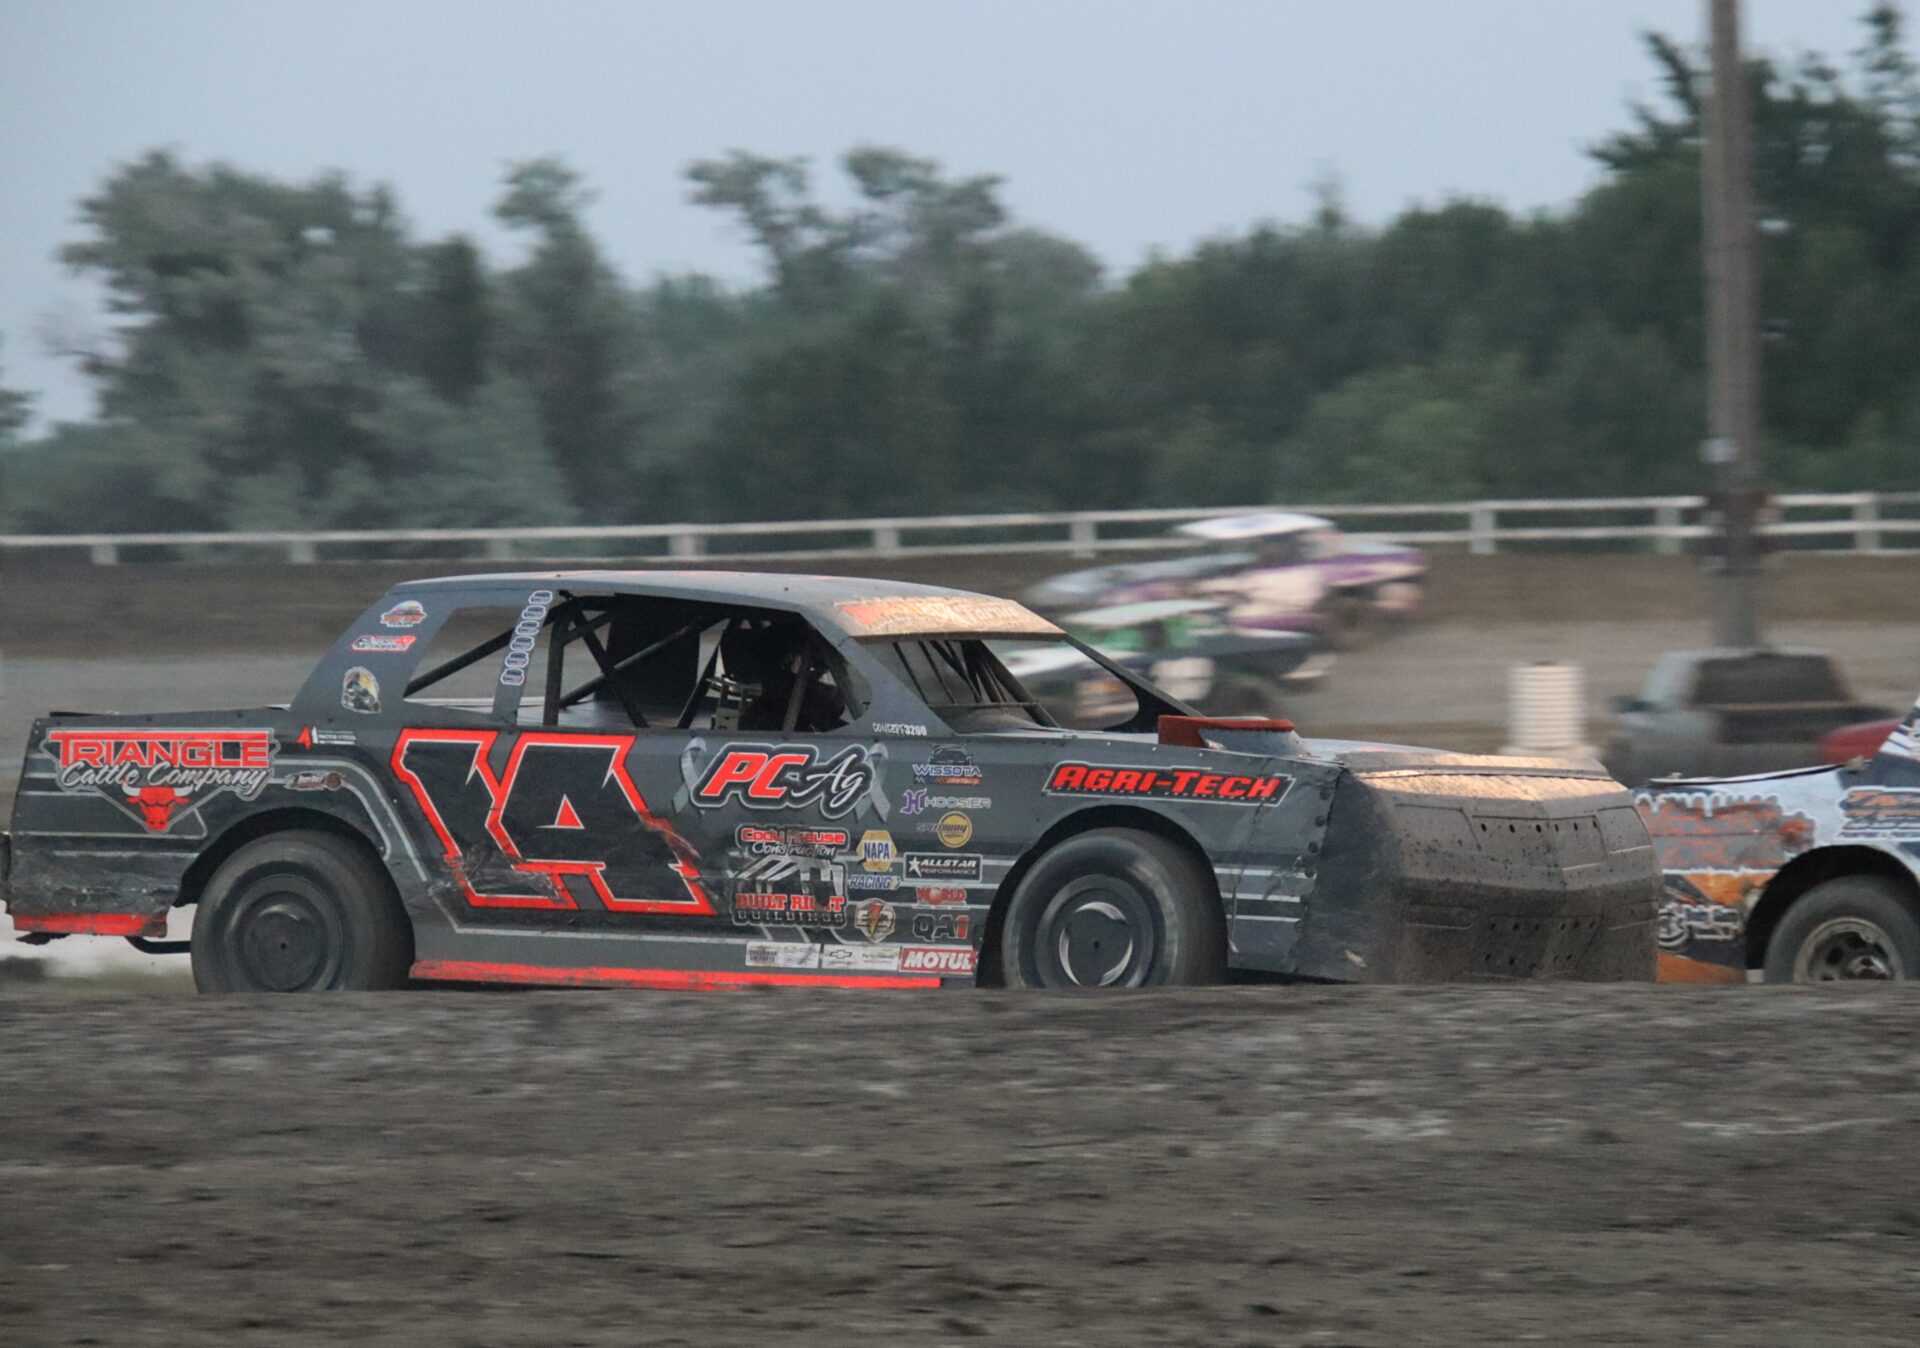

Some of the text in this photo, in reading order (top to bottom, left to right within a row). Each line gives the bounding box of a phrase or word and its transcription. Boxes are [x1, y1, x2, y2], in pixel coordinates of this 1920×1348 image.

[50, 731, 270, 768] TRIANGLE
[61, 760, 140, 787] Cattle
[147, 760, 269, 796] Company
[913, 764, 983, 777] WISSOTA
[701, 751, 866, 809] PC Ag
[1052, 766, 1281, 799] AGRI-TECH
[924, 797, 992, 809] HOOSIER
[864, 842, 891, 860] NAPA
[920, 859, 977, 868] ALLSTAR
[920, 866, 977, 875] PERFORMANCE
[849, 875, 892, 889] RACING
[736, 893, 788, 910] BUILT
[789, 895, 844, 912] RIT
[738, 911, 843, 922] BUILDINGS
[912, 913, 969, 942] QA1
[903, 951, 974, 970] MOTUL
